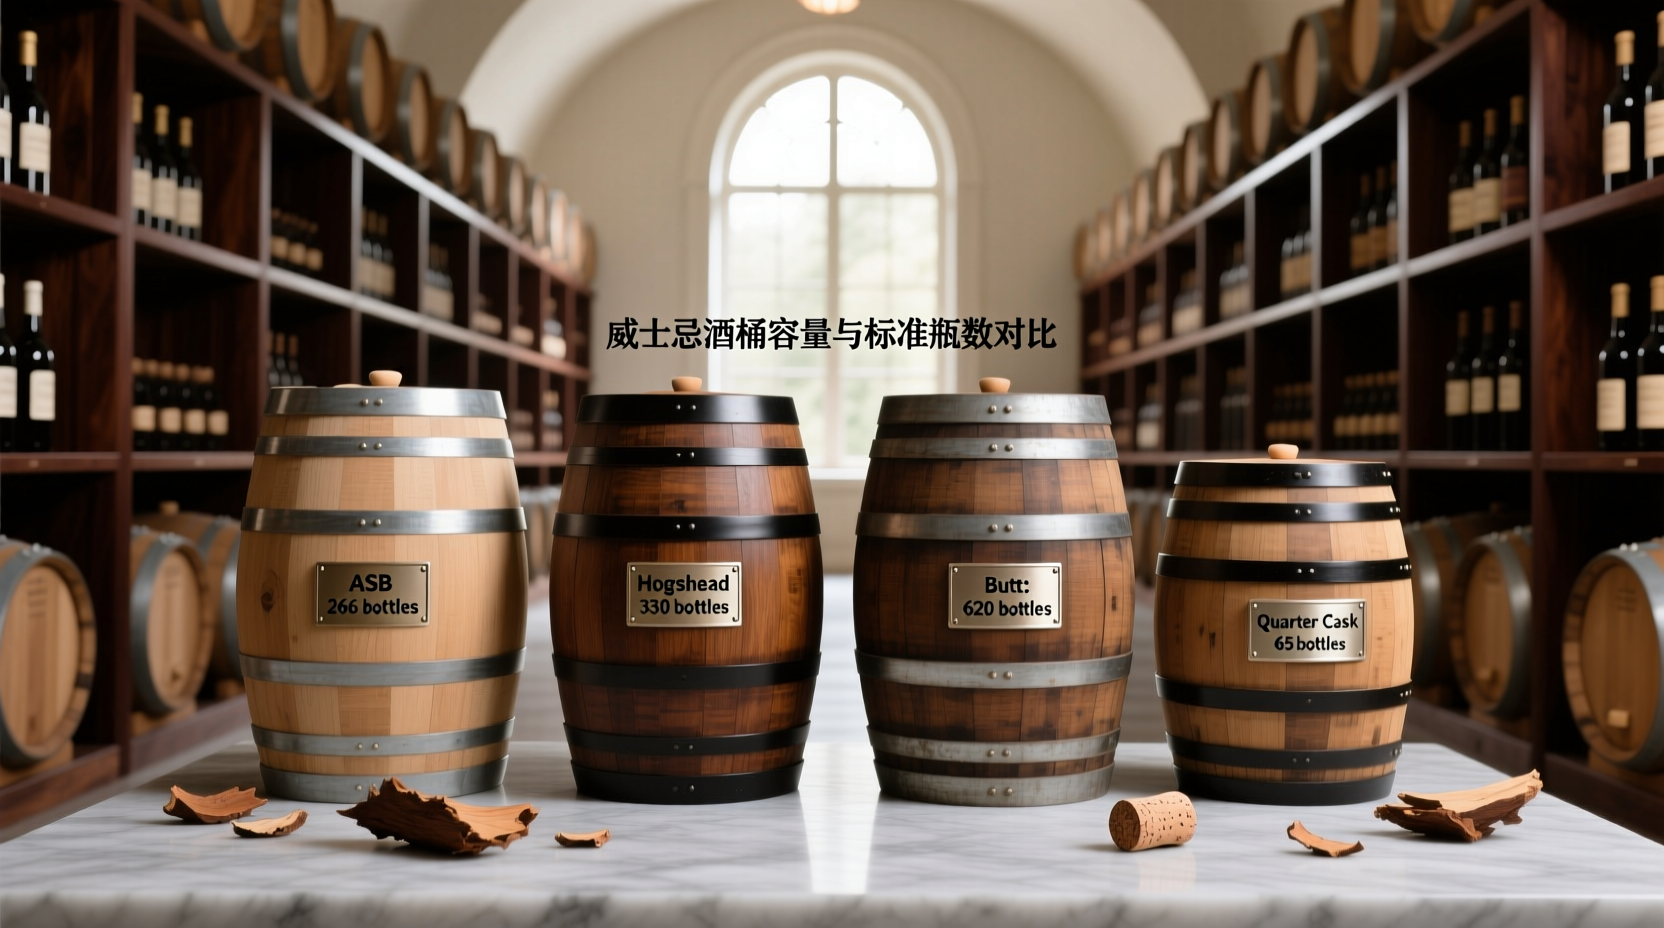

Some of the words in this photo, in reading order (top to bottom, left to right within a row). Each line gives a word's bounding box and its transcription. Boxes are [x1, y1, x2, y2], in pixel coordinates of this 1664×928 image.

[348, 574, 393, 592] ASB
[637, 574, 730, 596] Hogshead
[985, 576, 1030, 594] Butt:
[327, 598, 358, 615] 266
[362, 598, 419, 615] bottles
[639, 599, 671, 615] 330
[673, 598, 730, 615] bottles
[963, 600, 995, 616] 620
[998, 600, 1052, 616] bottles
[1257, 613, 1319, 633] Quarter
[1322, 612, 1359, 629] Cask
[1274, 635, 1294, 651] 65
[1296, 635, 1346, 651] bottles
